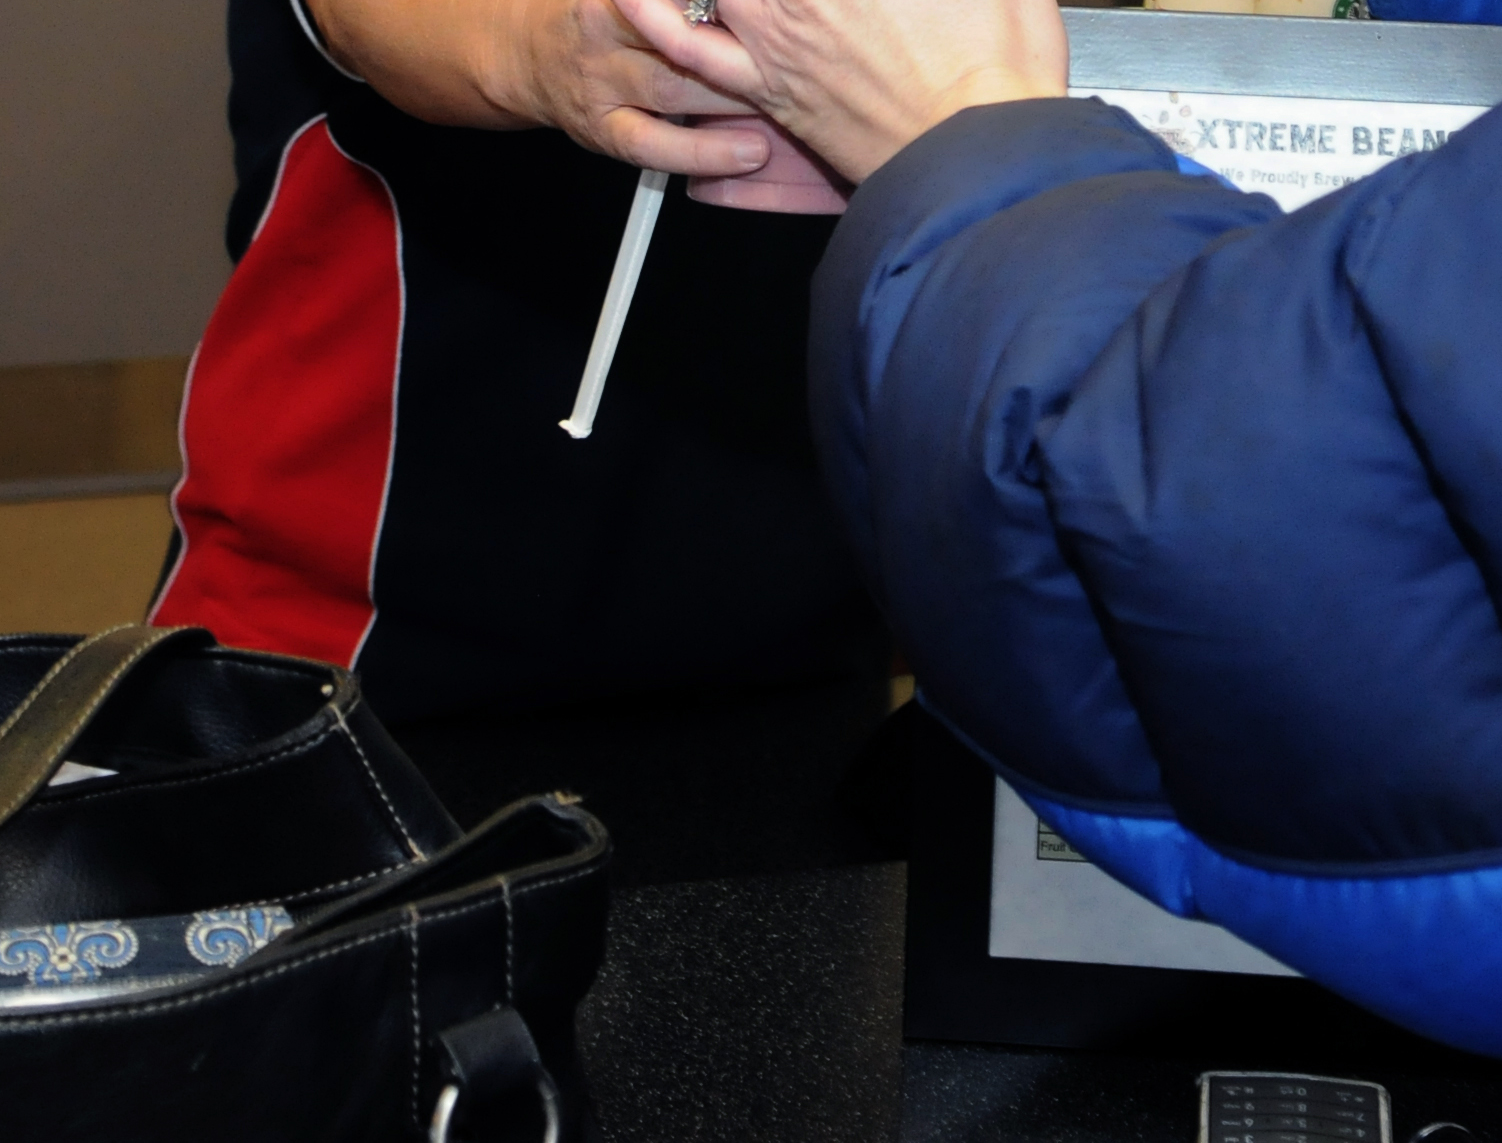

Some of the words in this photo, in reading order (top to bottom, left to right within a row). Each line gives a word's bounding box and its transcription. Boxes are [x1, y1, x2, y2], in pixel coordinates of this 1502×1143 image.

[1197, 118, 1336, 154] XTREME
[1352, 126, 1460, 158] BEAN
[1250, 169, 1307, 189] Proudly
[1040, 840, 1066, 852] Fruit
